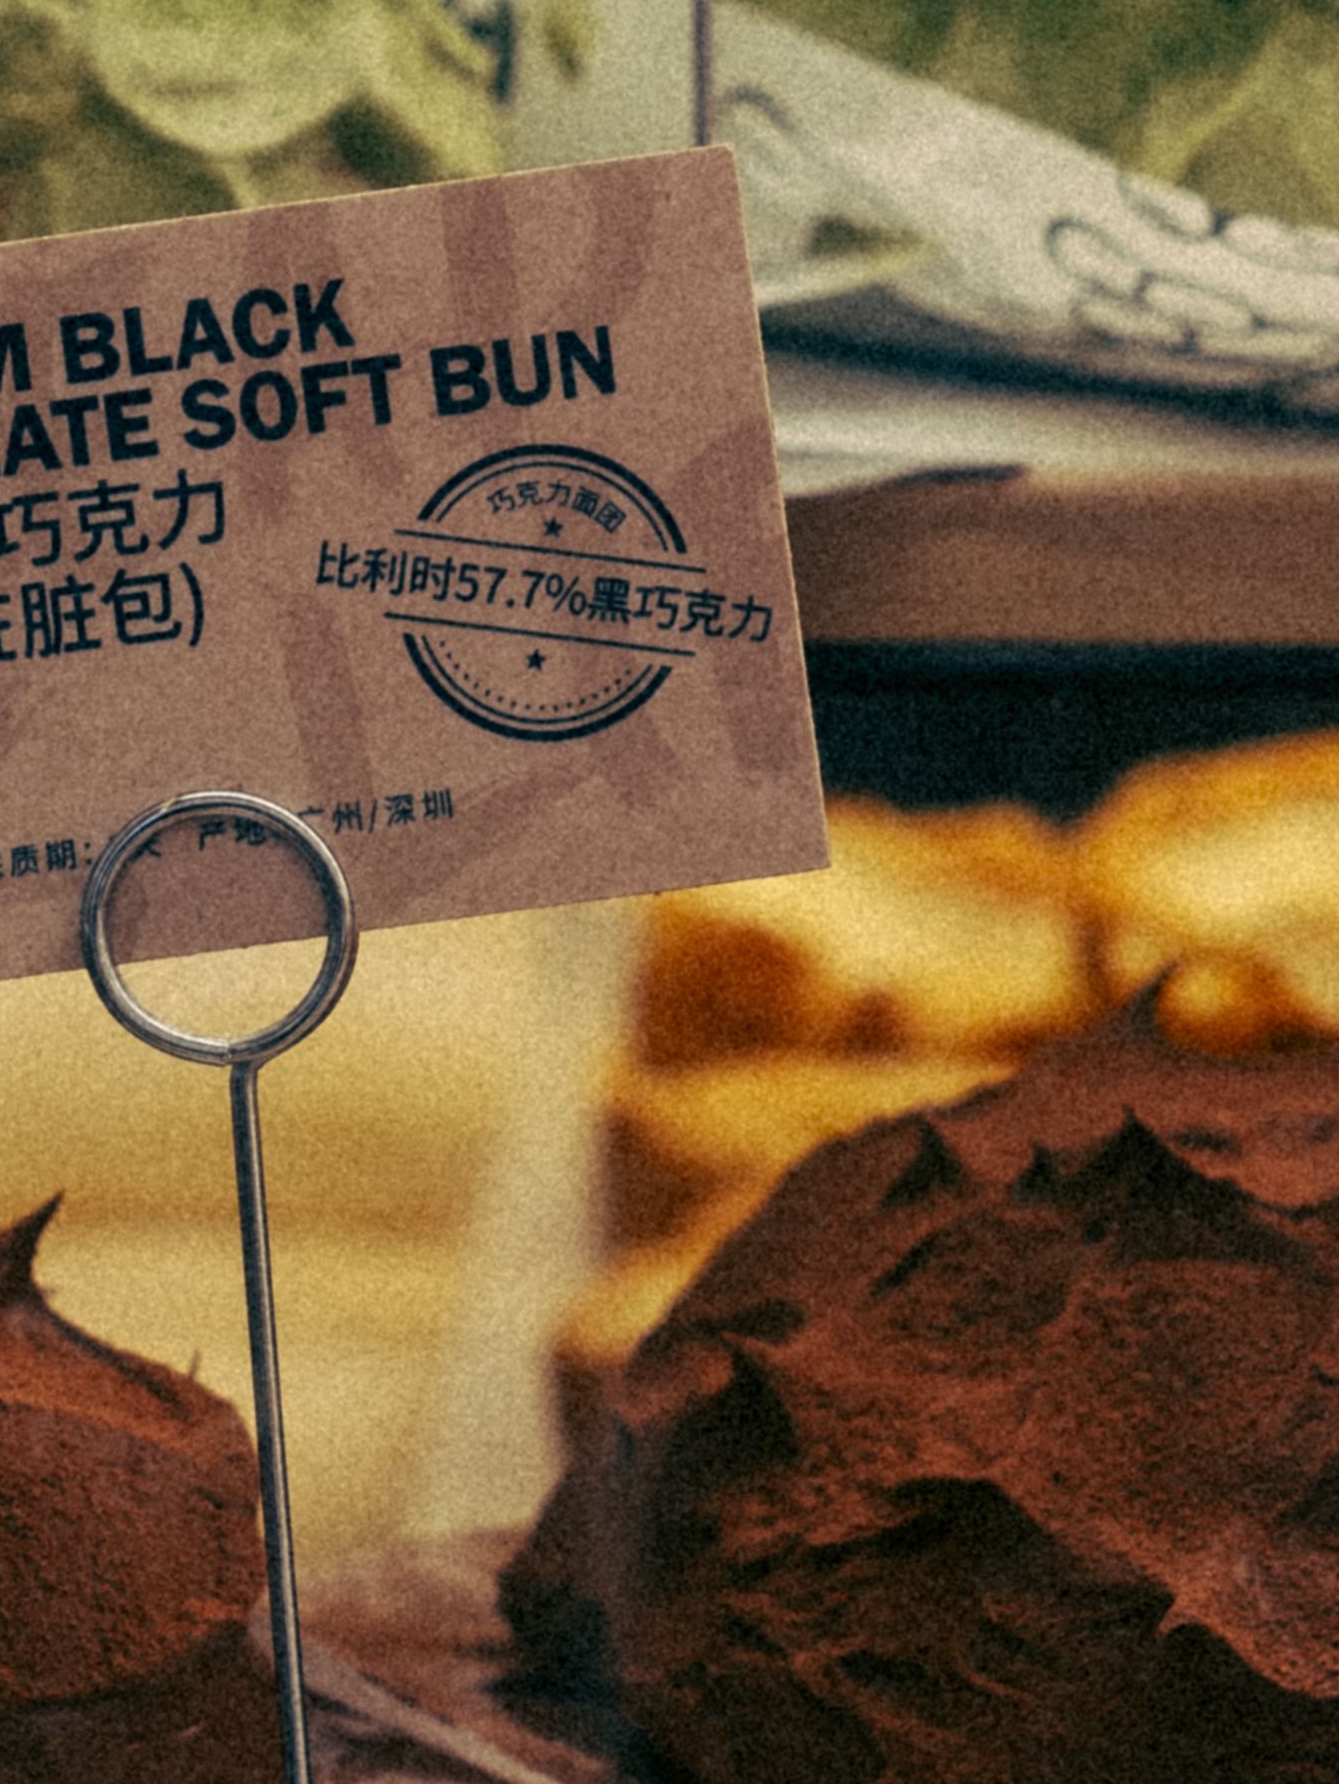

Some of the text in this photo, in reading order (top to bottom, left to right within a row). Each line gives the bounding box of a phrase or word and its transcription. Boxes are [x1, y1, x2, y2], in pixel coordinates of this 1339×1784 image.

[59, 279, 355, 384] BLACK
[181, 354, 401, 450] SOFT
[430, 326, 615, 416] BUN
[488, 482, 625, 533] 巧克力面团
[316, 541, 772, 644] 比利时57.7%黑巧克力
